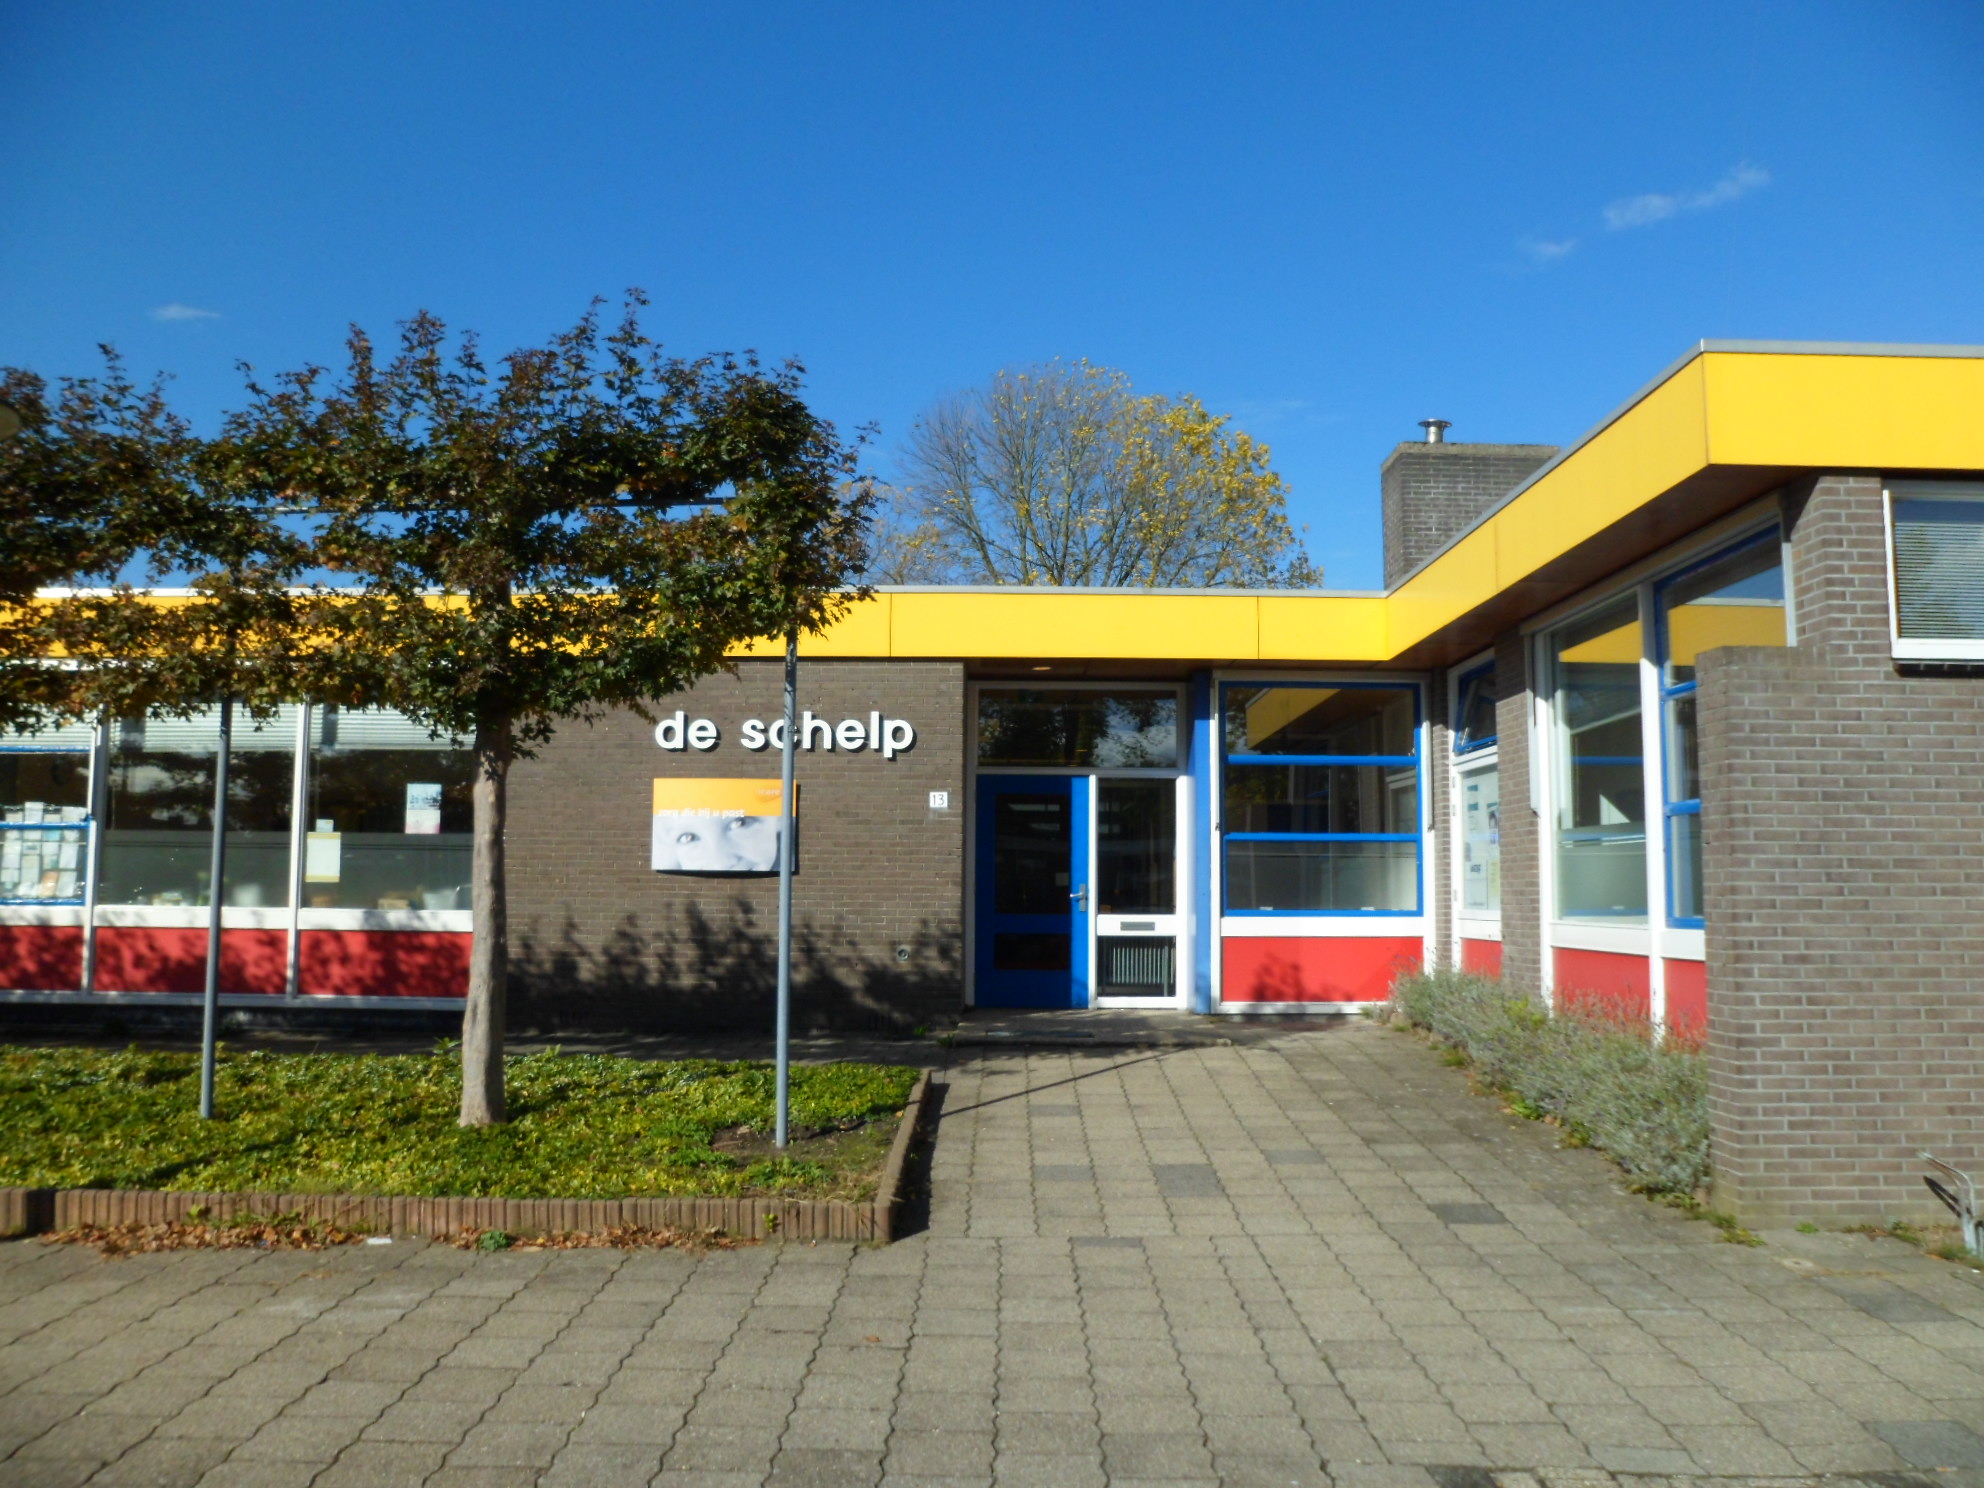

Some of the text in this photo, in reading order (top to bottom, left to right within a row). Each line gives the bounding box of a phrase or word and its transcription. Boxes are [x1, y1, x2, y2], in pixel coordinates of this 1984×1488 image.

[655, 711, 913, 758] de schelp
[932, 794, 944, 806] 13
[658, 807, 745, 819] zorg die bij u past
